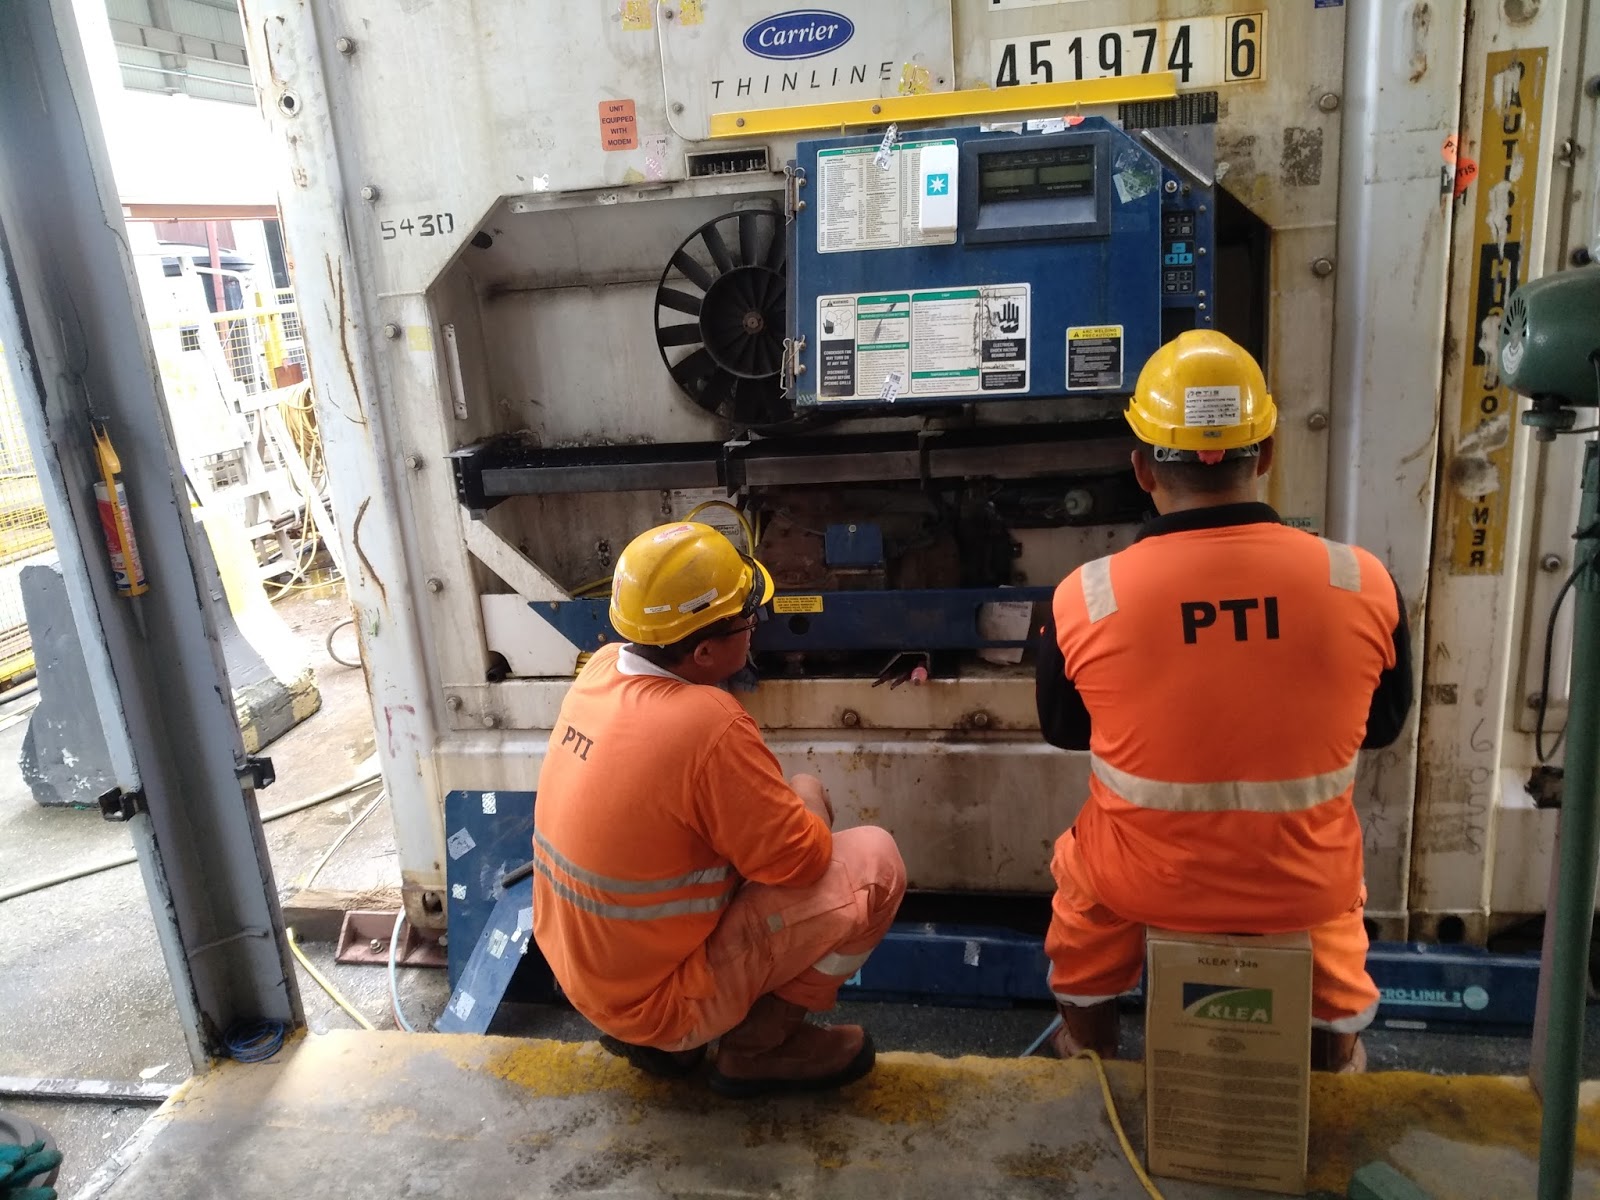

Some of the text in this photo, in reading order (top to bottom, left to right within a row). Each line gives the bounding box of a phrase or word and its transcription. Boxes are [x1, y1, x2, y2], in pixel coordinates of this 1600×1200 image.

[759, 22, 838, 47] Carrier
[996, 18, 1256, 88] 451974 6
[711, 61, 894, 99] THINLINE
[602, 116, 634, 124] EQUIPPED
[607, 138, 632, 146] MODEM
[1181, 597, 1280, 644] PTI
[561, 725, 594, 761] PTI
[1208, 1005, 1269, 1022] KLEA
